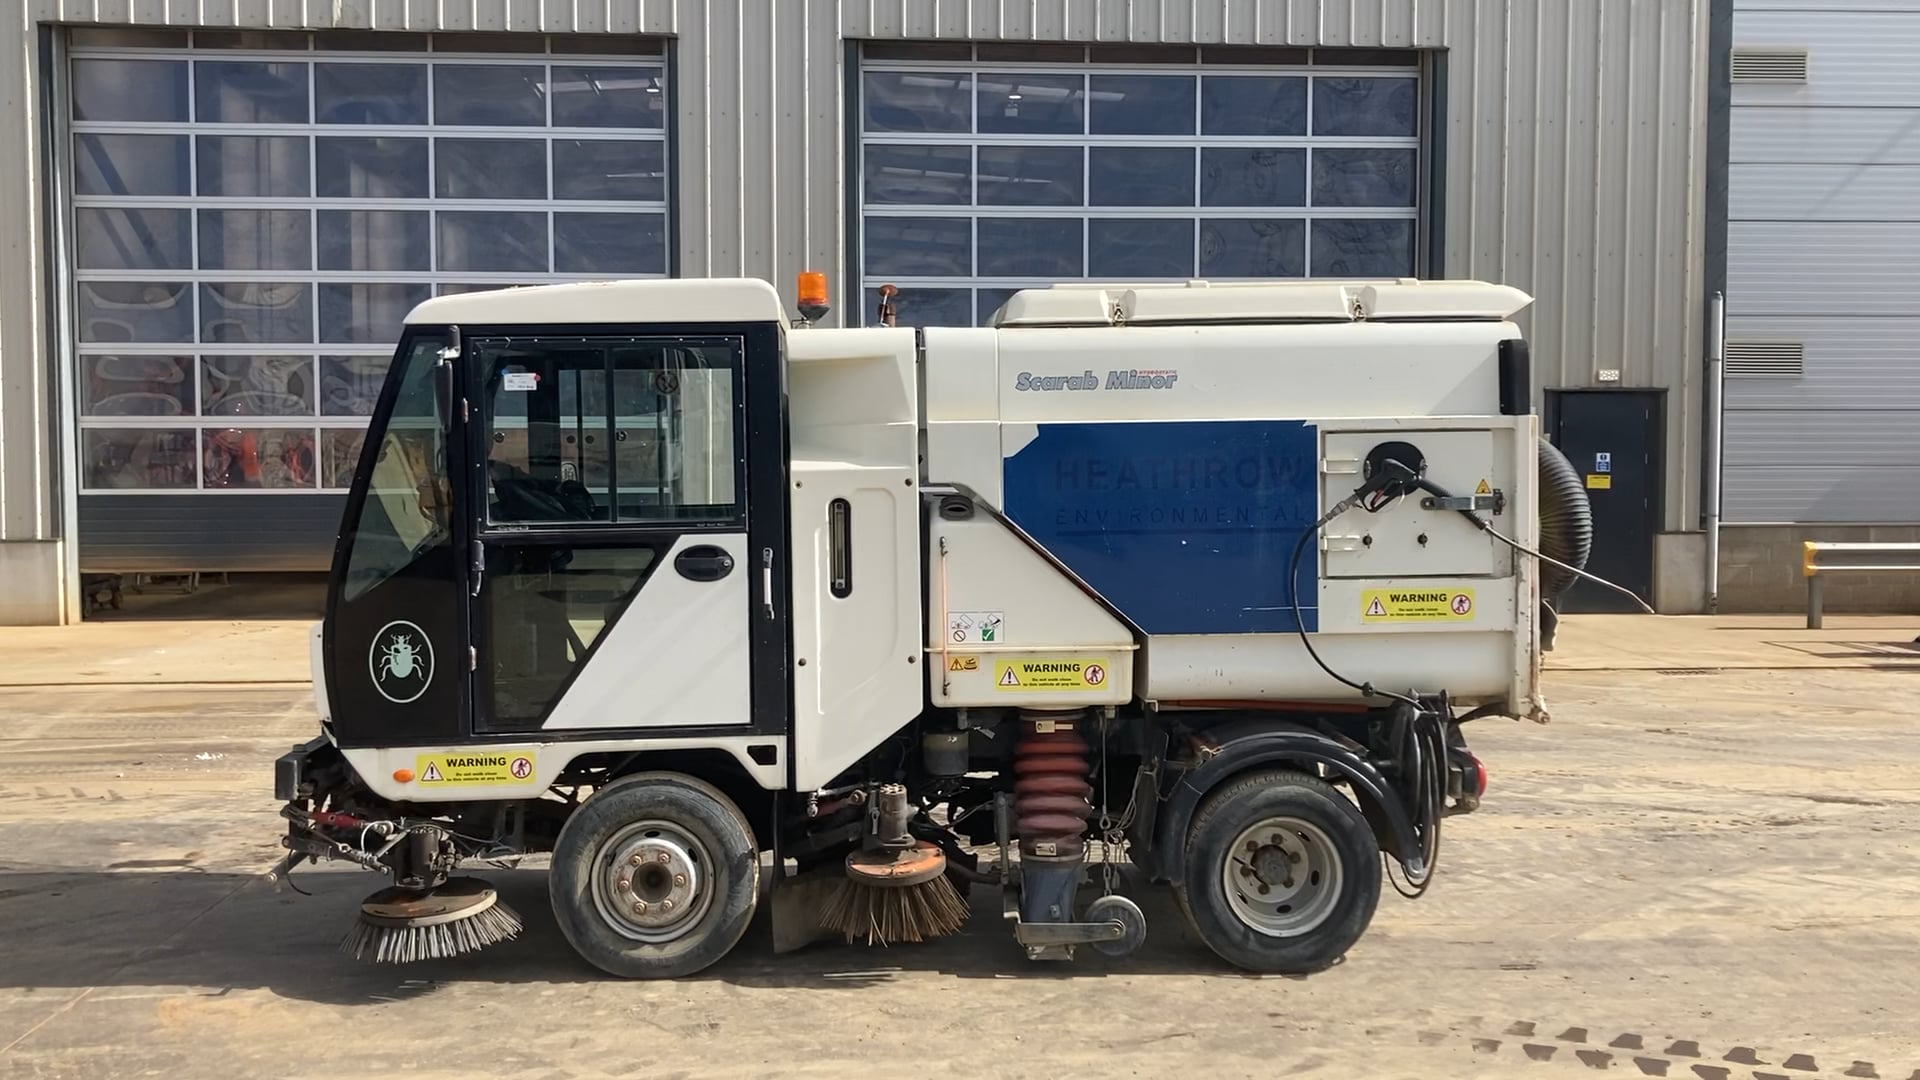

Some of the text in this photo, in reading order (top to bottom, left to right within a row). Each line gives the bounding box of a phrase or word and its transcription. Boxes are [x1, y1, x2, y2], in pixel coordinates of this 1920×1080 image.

[1015, 369, 1178, 391] Scarab Minor
[1055, 456, 1304, 491] HEATHROW
[1055, 504, 1305, 525] ENVIRONMENTAL
[1389, 593, 1447, 602] WARNING
[1023, 664, 1081, 672] WARNING
[446, 757, 506, 767] WARNING
